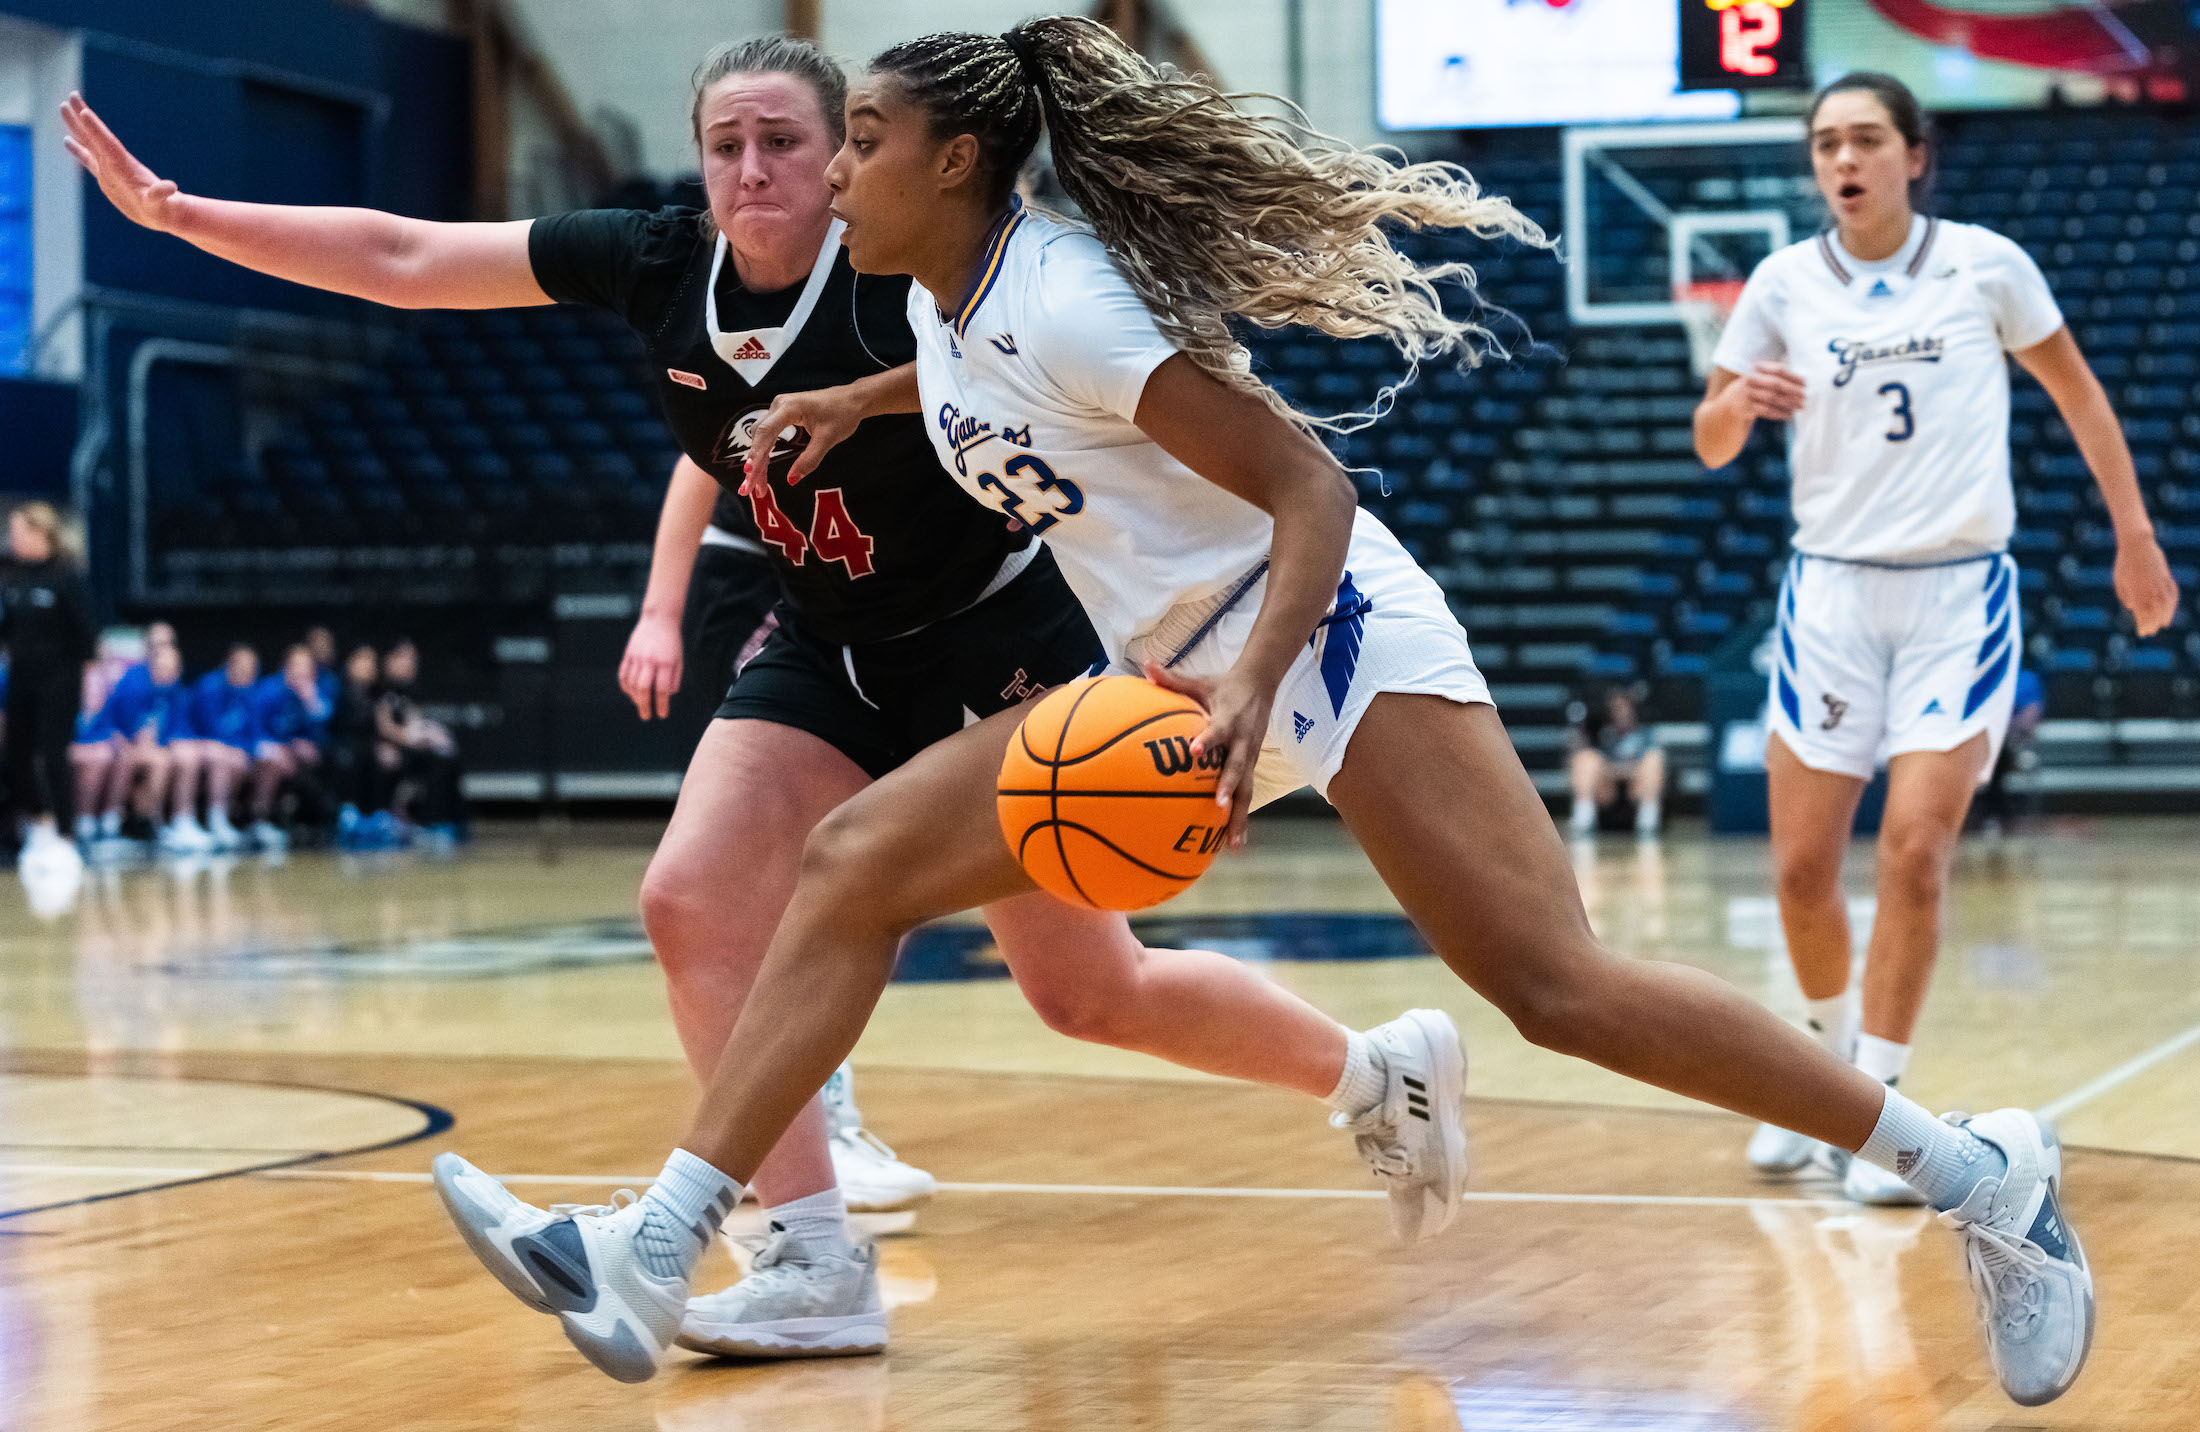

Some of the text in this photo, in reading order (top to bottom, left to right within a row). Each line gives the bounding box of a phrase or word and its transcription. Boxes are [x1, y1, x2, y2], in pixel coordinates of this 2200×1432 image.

[1719, 2, 1782, 76] 12
[733, 350, 771, 360] adidas
[1877, 380, 1914, 442] 3
[976, 452, 1086, 537] 23
[749, 483, 875, 581] 44
[1296, 718, 1315, 744] adidas
